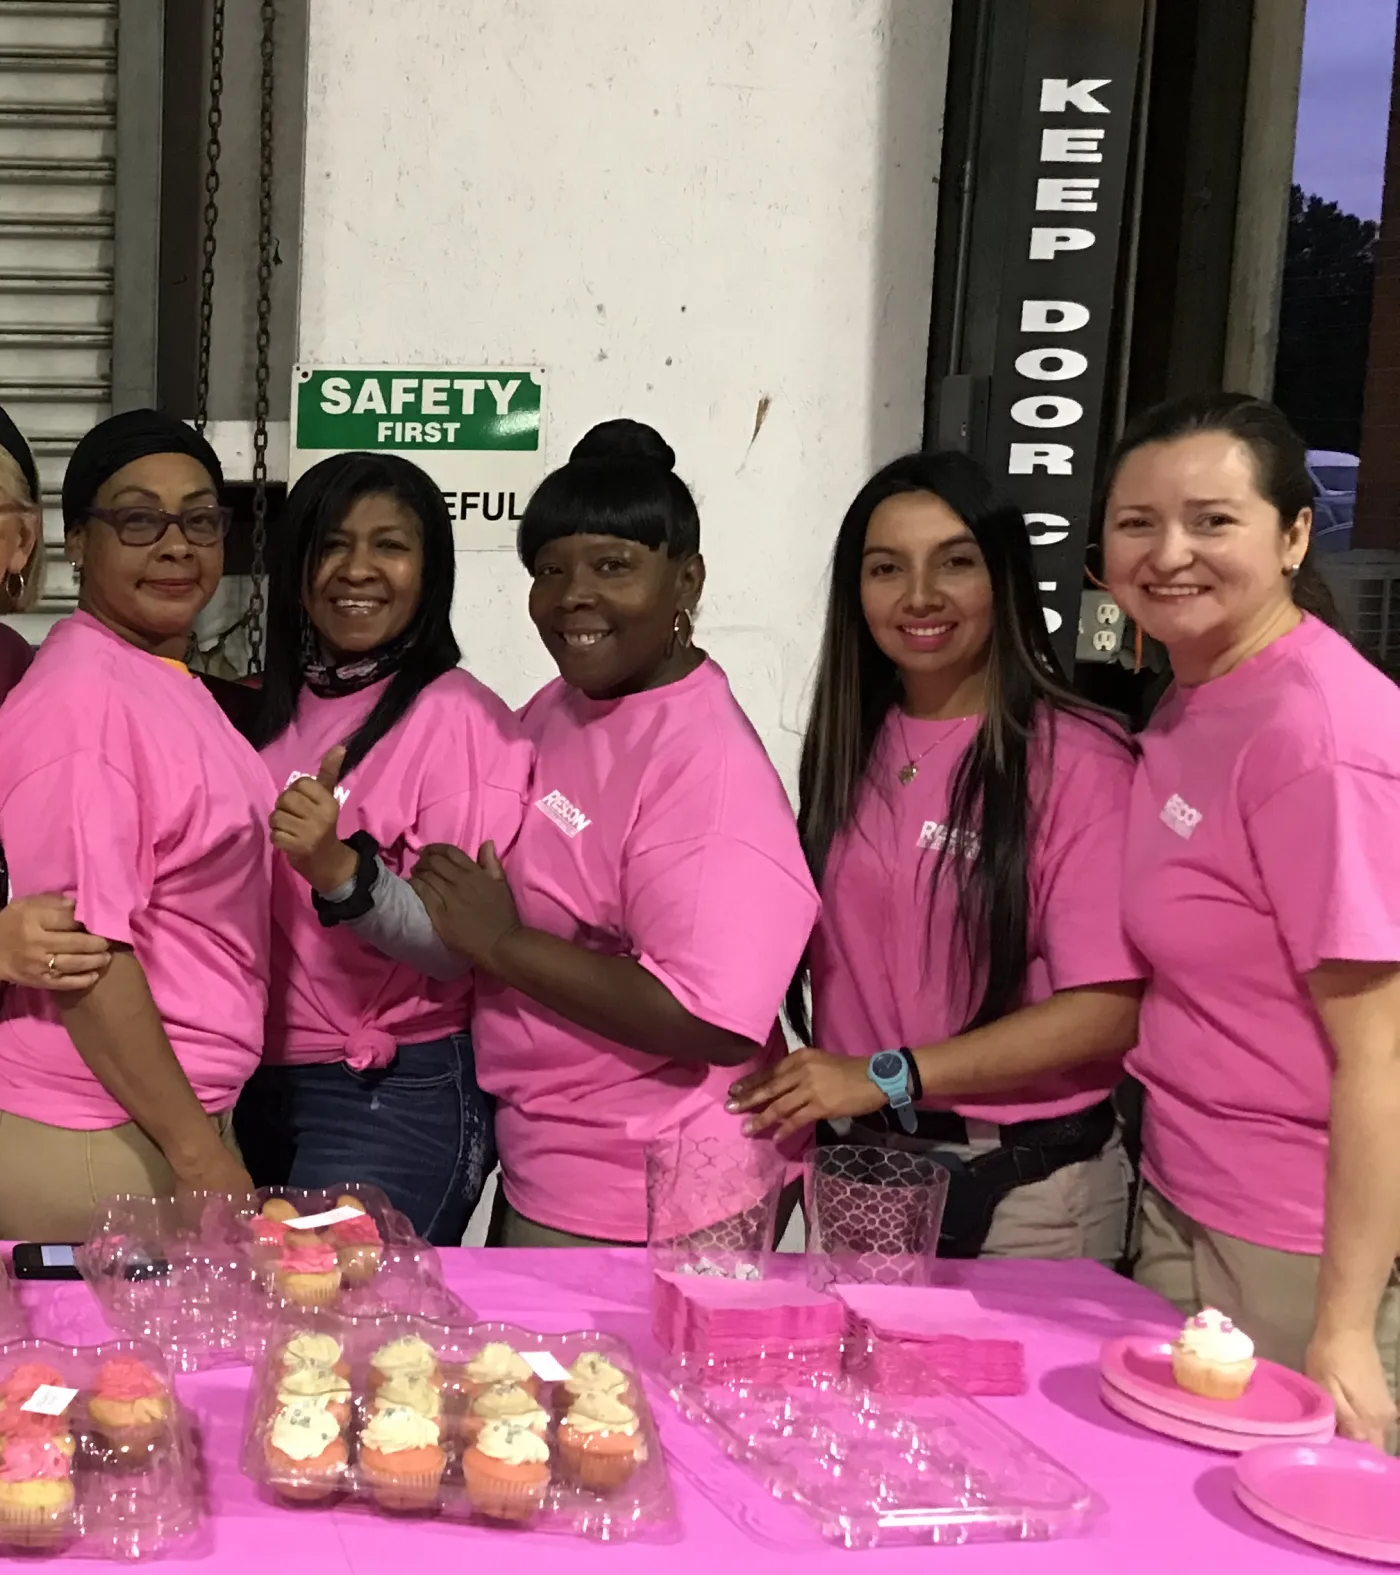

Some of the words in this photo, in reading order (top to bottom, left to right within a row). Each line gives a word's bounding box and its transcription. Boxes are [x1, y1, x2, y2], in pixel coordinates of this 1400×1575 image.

[1029, 78, 1113, 261] KEEP
[319, 376, 523, 416] SAFETY
[377, 421, 461, 443] FIRST
[1008, 299, 1091, 476] DOOR
